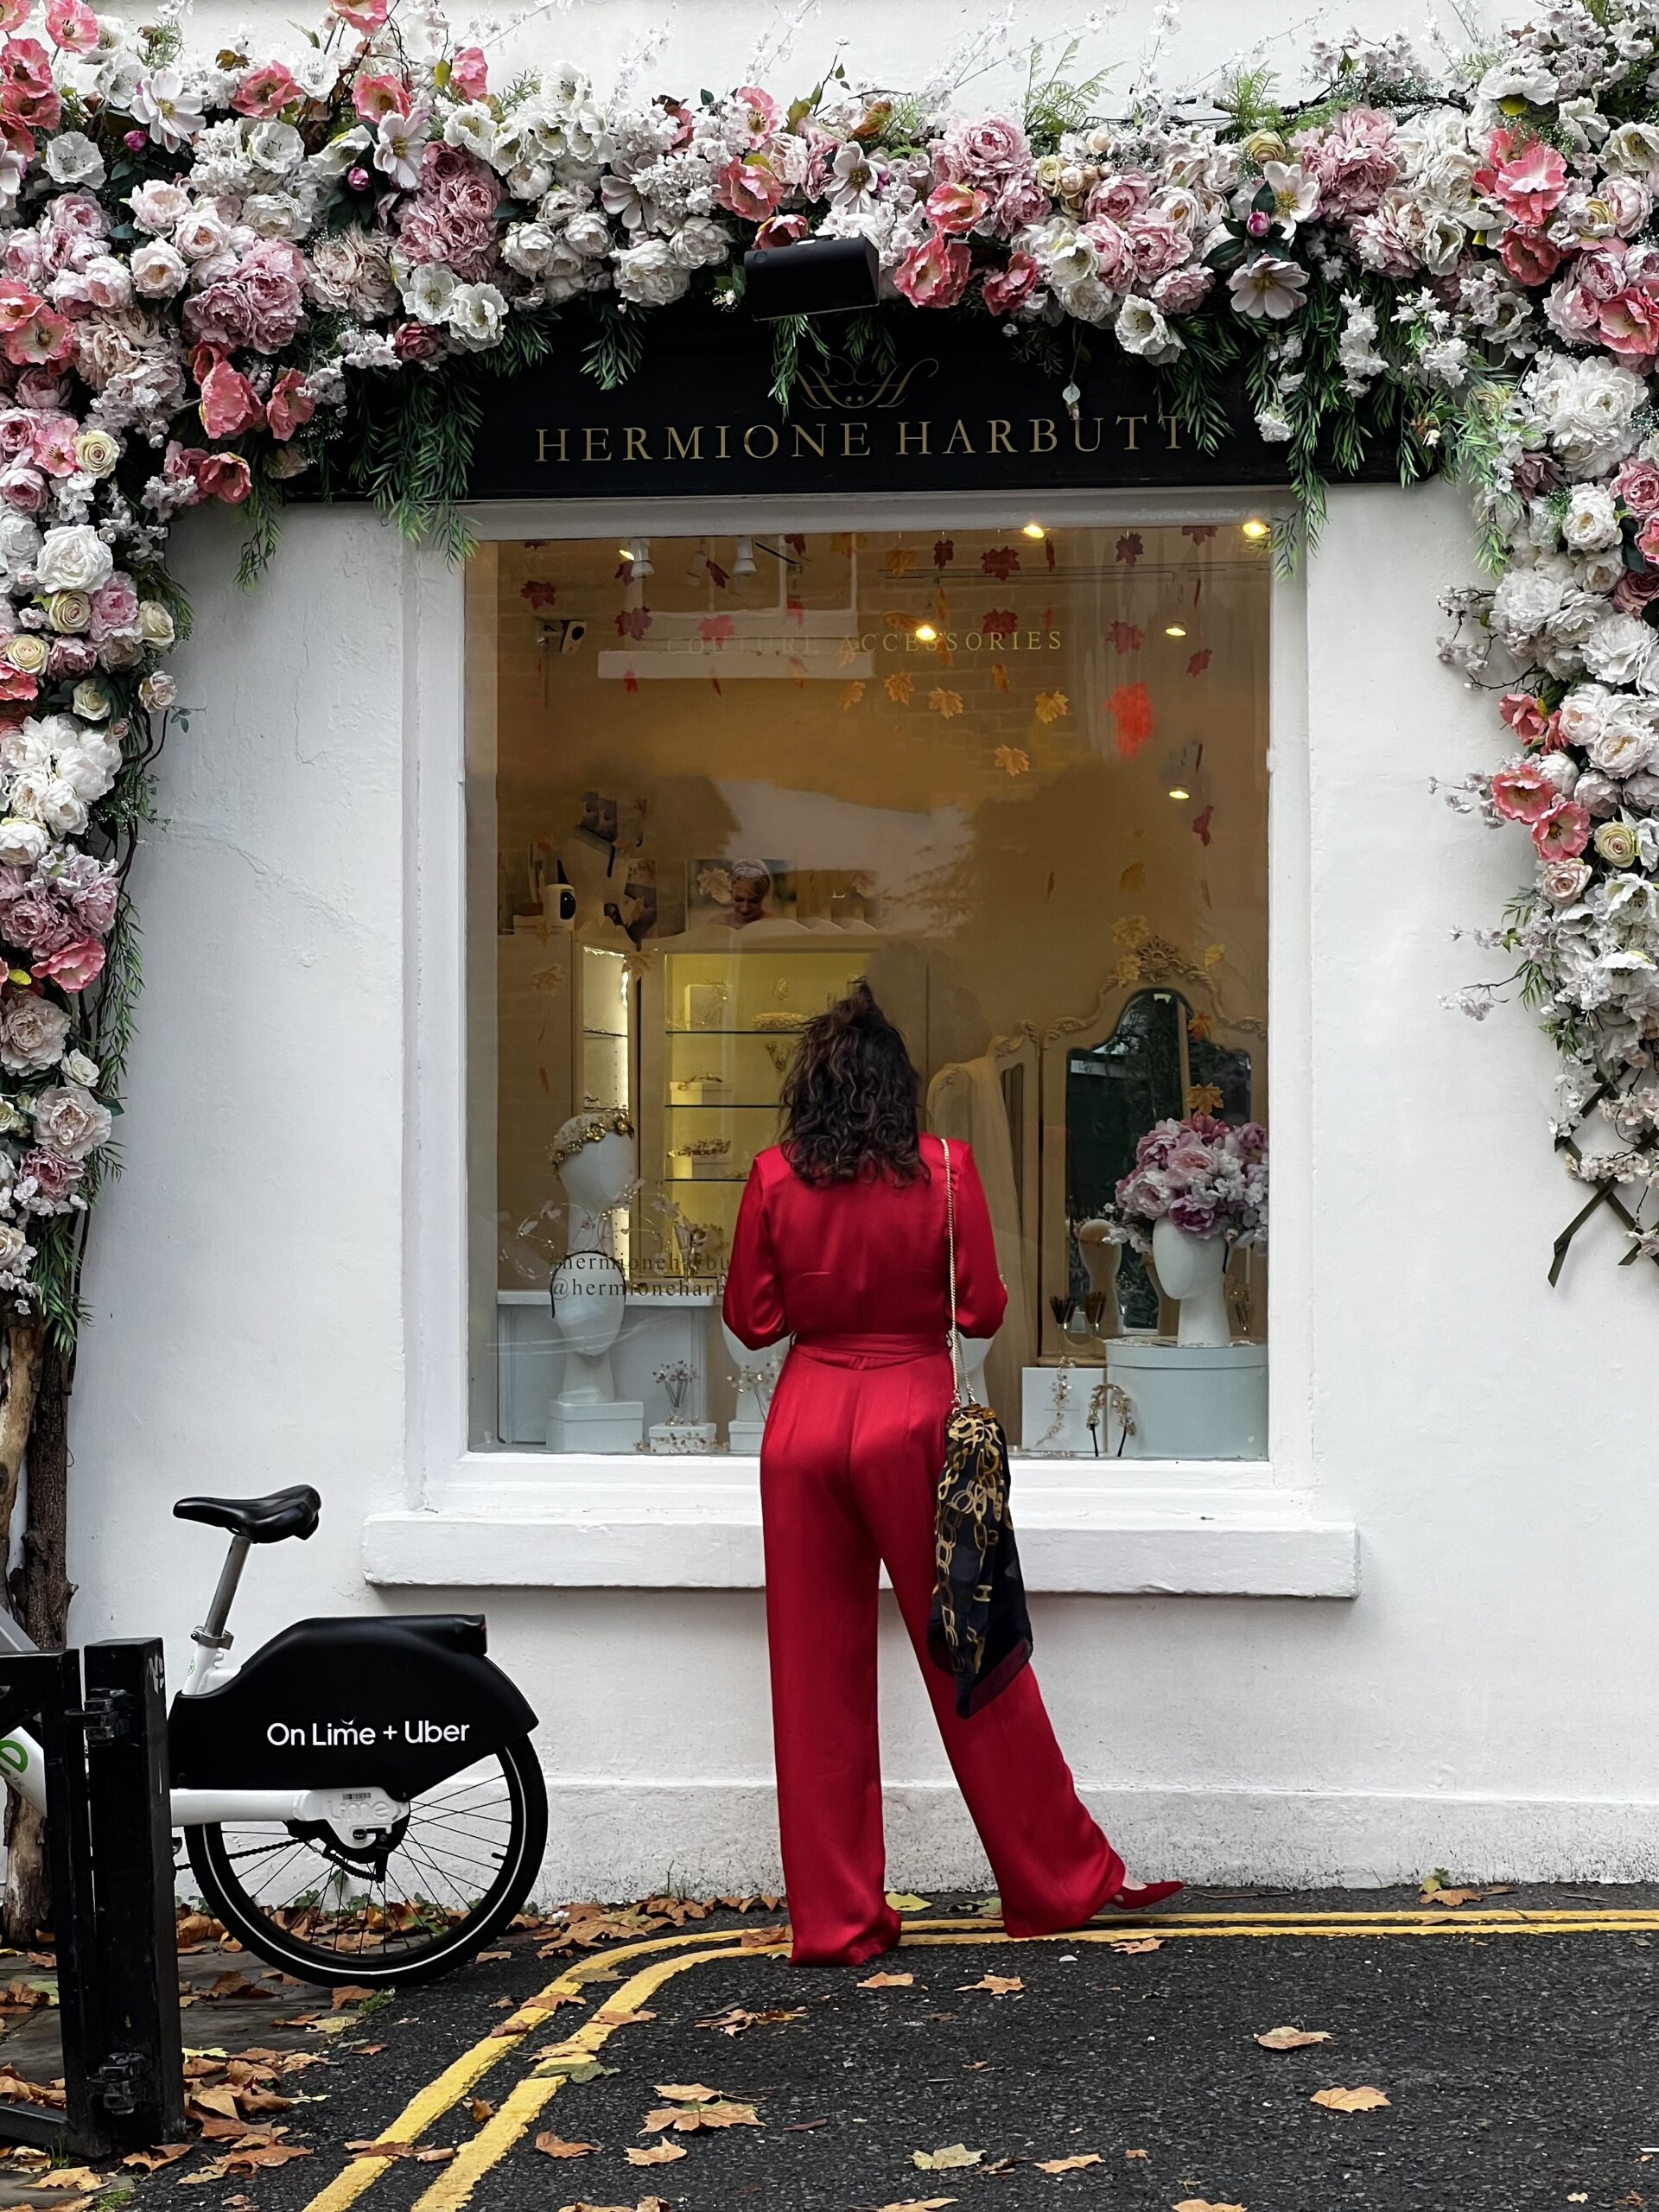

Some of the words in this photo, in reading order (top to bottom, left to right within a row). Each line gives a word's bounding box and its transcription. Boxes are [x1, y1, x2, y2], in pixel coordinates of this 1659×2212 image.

[534, 423, 871, 462] HERMIONE
[895, 415, 1187, 455] HARBUTT
[840, 631, 1062, 654] ACCESSORIES
[267, 1722, 305, 1746] On
[312, 1723, 377, 1746] Lime
[404, 1719, 470, 1744] Uber
